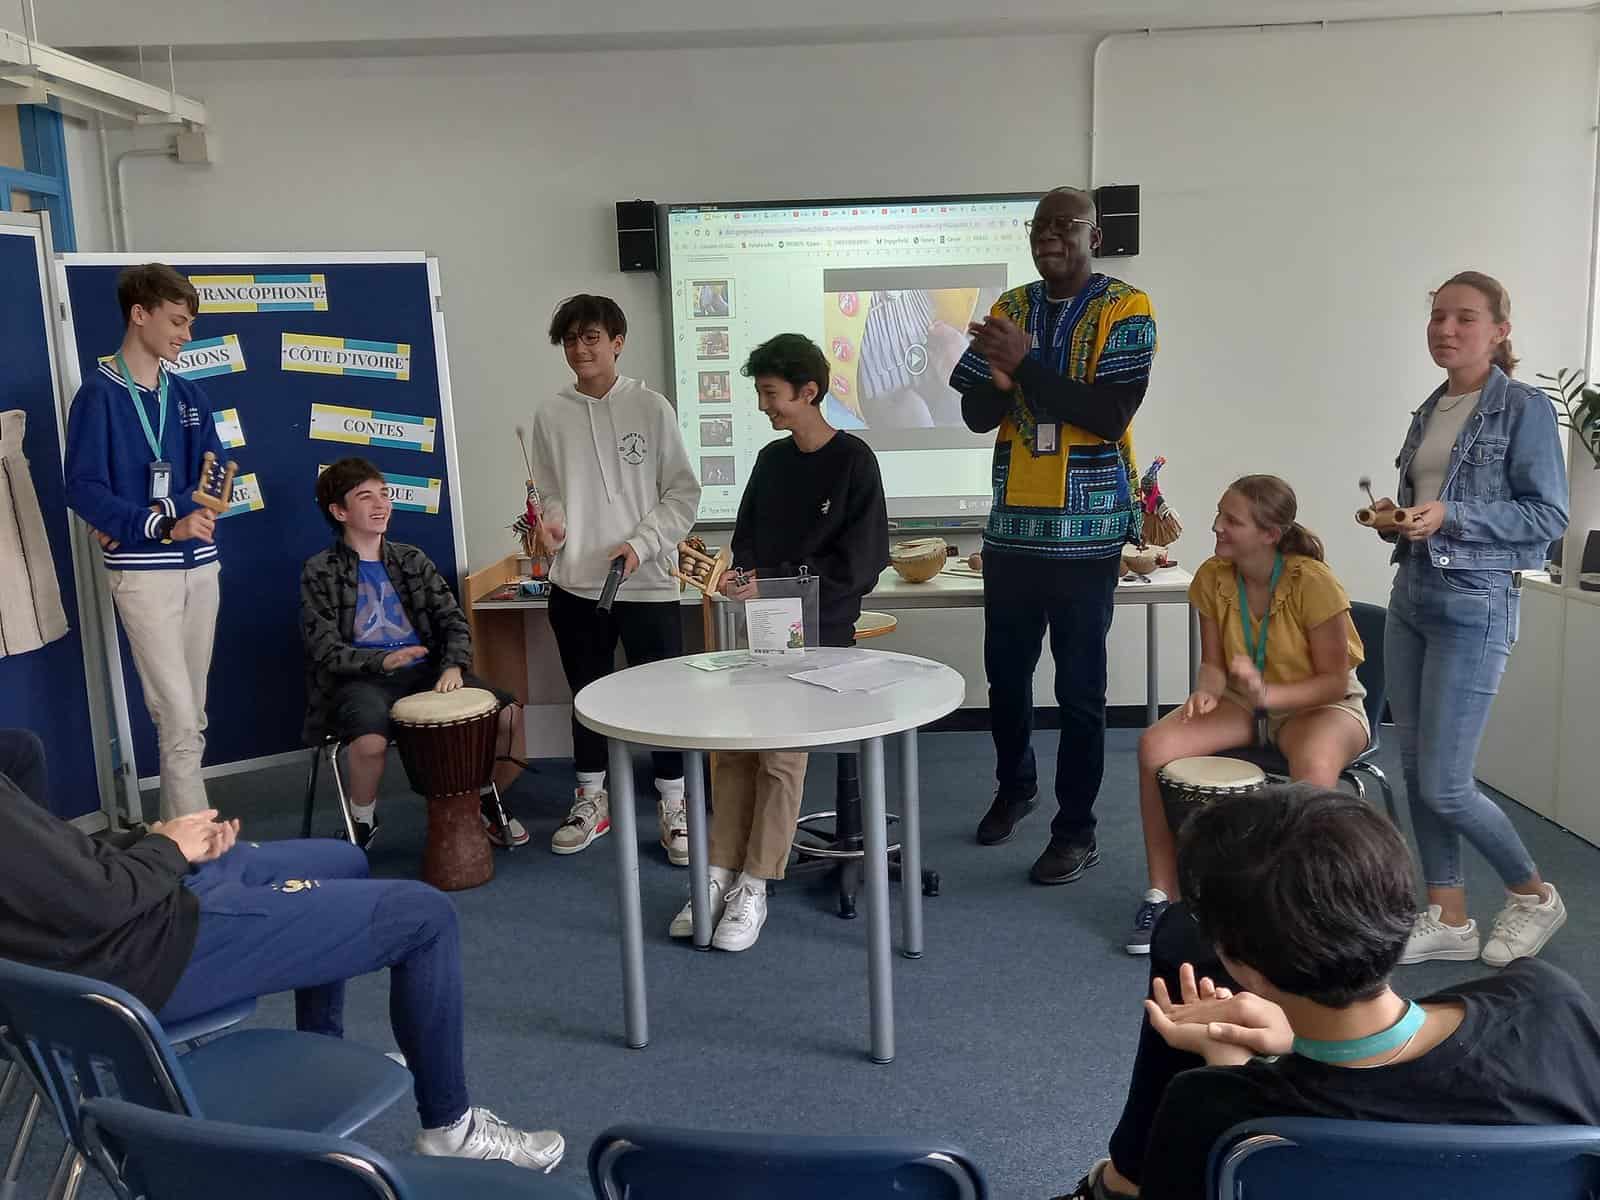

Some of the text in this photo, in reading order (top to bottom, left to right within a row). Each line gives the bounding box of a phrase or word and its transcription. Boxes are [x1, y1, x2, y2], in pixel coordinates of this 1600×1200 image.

[288, 345, 404, 370] CÔTE D'IVOIRE
[343, 418, 405, 437] CONTES
